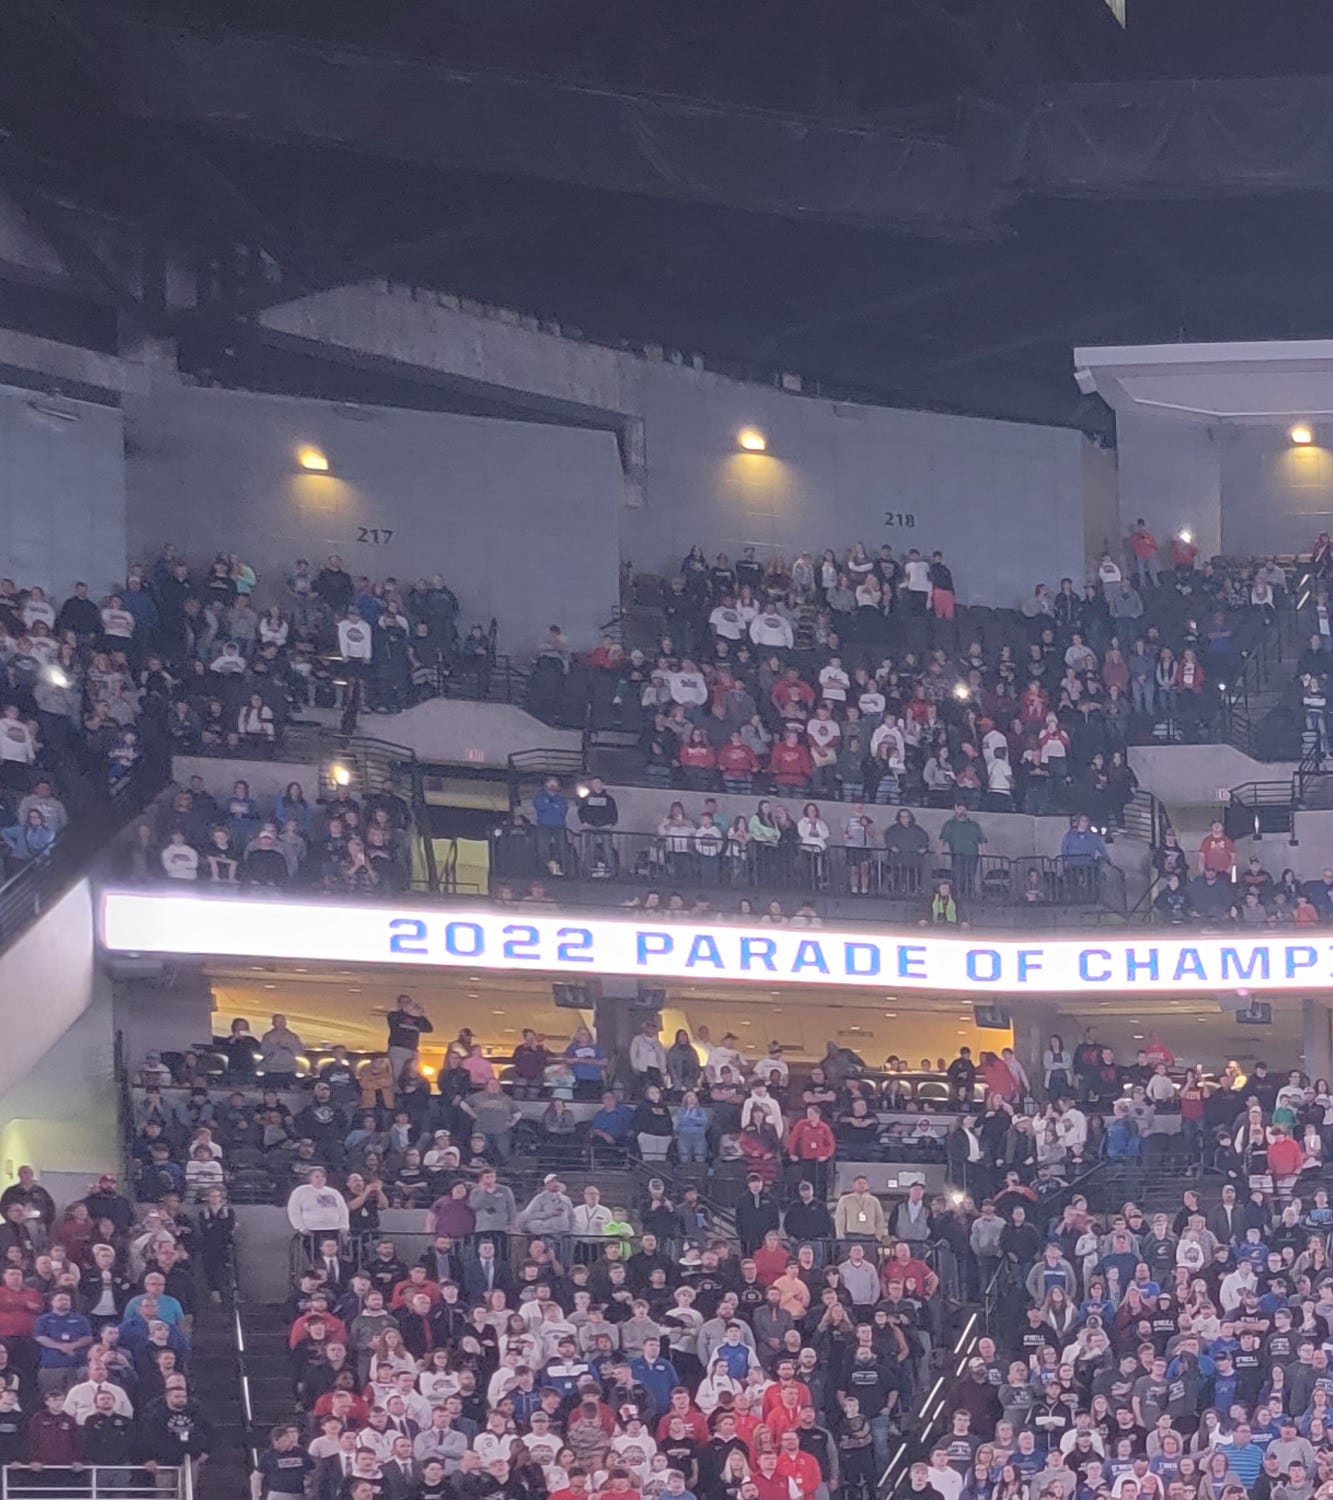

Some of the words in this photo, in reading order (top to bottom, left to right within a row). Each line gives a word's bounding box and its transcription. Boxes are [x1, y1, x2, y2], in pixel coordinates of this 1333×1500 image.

[884, 512, 915, 527] 218
[357, 527, 393, 544] 217
[390, 919, 593, 962] 2022
[637, 931, 927, 979] PARADE
[966, 949, 1042, 983] OF
